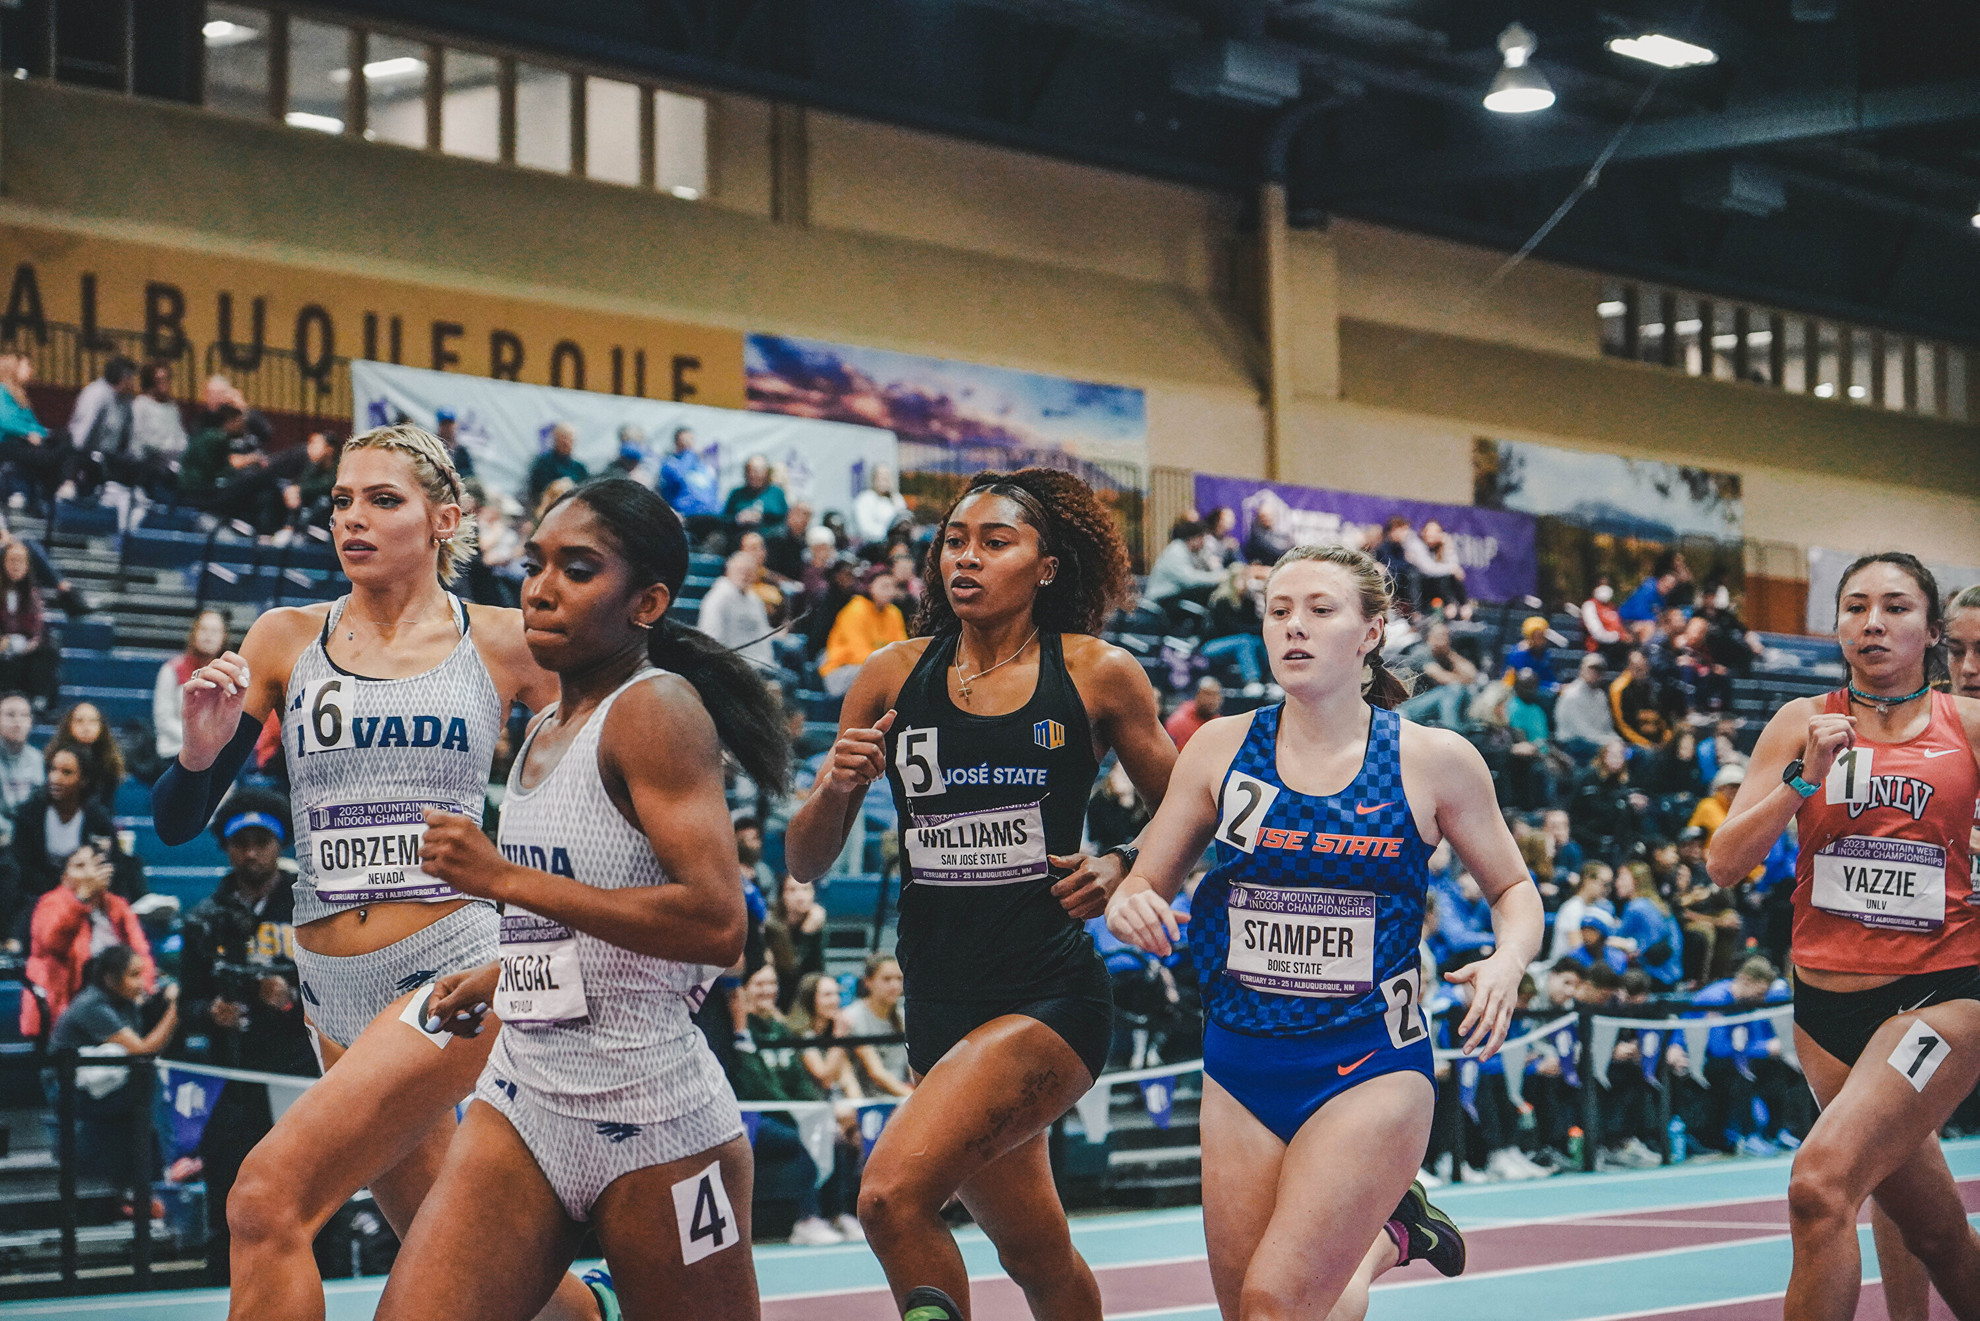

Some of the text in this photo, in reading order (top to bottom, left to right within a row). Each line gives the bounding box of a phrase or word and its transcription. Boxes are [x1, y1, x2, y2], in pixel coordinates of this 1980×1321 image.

[1, 262, 702, 402] ALBUQUERQUE
[312, 680, 342, 747] 6
[298, 715, 469, 758] VADA
[906, 732, 933, 793] 5
[943, 762, 1048, 786] JOSÉ STATE
[1837, 750, 1858, 800] 1
[334, 815, 372, 827] INDOOR
[339, 806, 365, 817] 2023
[368, 803, 423, 814] MOUNTAIN
[1226, 781, 1263, 848] 2
[918, 818, 1028, 849] WILLIAMS
[1256, 827, 1404, 858] ISE STATE
[941, 852, 1008, 866] SAN JOSÉ STATE
[1837, 847, 1871, 858] INDOOR
[1873, 850, 1943, 867] CHAMPIONSHIPS
[1843, 839, 1866, 849] 2023
[1867, 841, 1915, 853] MOUNTAIN
[1916, 846, 1939, 857] WEST
[368, 871, 405, 885] NEVADA
[923, 871, 949, 879] FEBRUARY
[1021, 867, 1032, 875] NM
[1843, 865, 1917, 898] YAZZIE
[359, 892, 370, 900] 23
[374, 891, 384, 899] 25
[440, 887, 451, 895] NM
[1254, 890, 1366, 907] 2023 MOUNTAIN WEST
[1866, 899, 1888, 911] UNLV
[1249, 900, 1372, 916] INDOOR CHAMPIONSHIPS
[1244, 919, 1354, 958] STAMPER
[1268, 959, 1323, 975] BOISE STATE
[1240, 974, 1267, 985] FEBRUARY
[1268, 978, 1277, 986] 23
[1294, 981, 1342, 992] ALBUQUERQUE,
[1392, 978, 1422, 1043] 2
[1907, 1036, 1940, 1079] 1
[690, 1174, 727, 1247] 4
